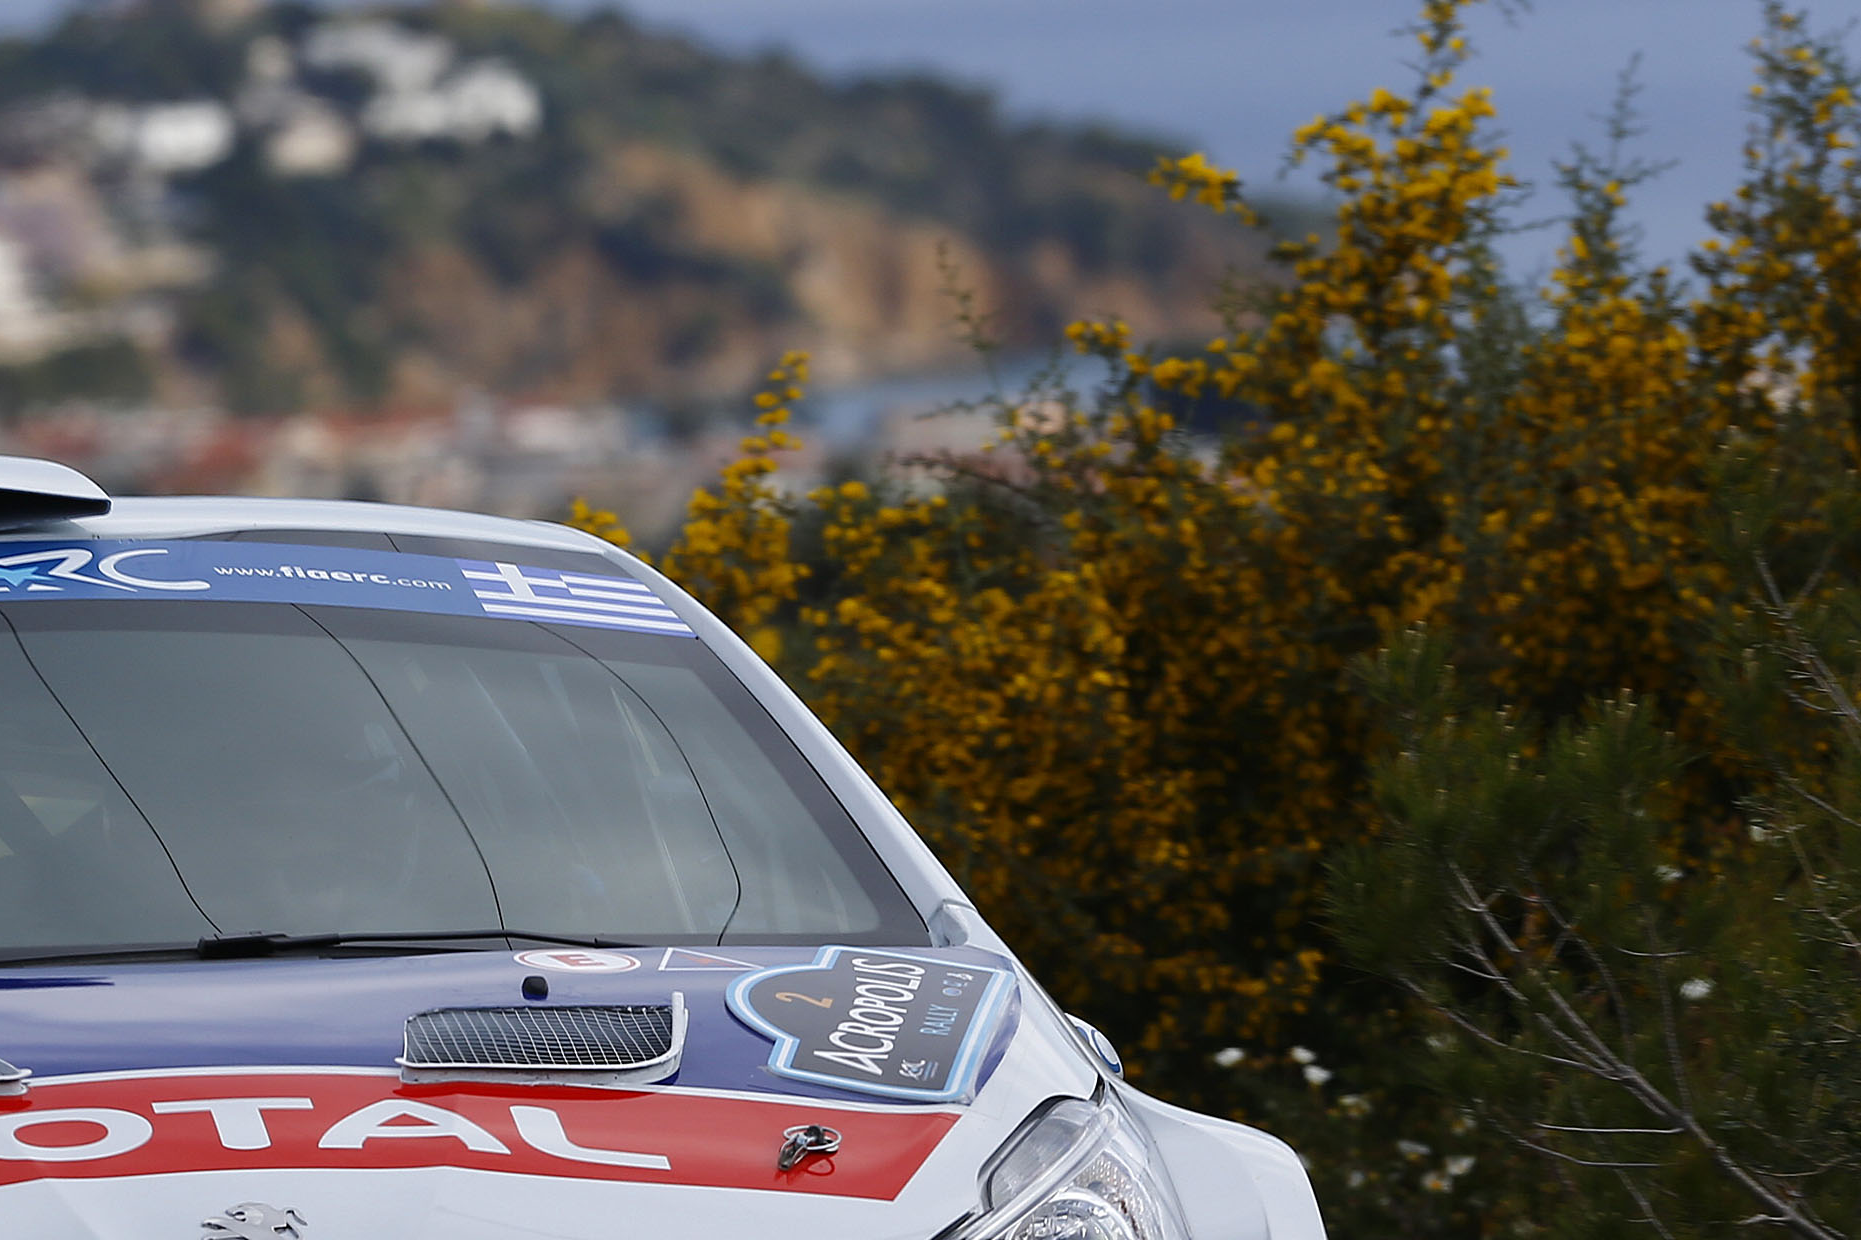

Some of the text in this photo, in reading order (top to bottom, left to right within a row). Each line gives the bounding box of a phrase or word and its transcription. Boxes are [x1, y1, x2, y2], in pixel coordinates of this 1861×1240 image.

[213, 565, 452, 591] www.fiaerc.com
[775, 990, 835, 1010] 2
[813, 957, 926, 1077] ACROPOLIS
[920, 1003, 960, 1036] RALLY
